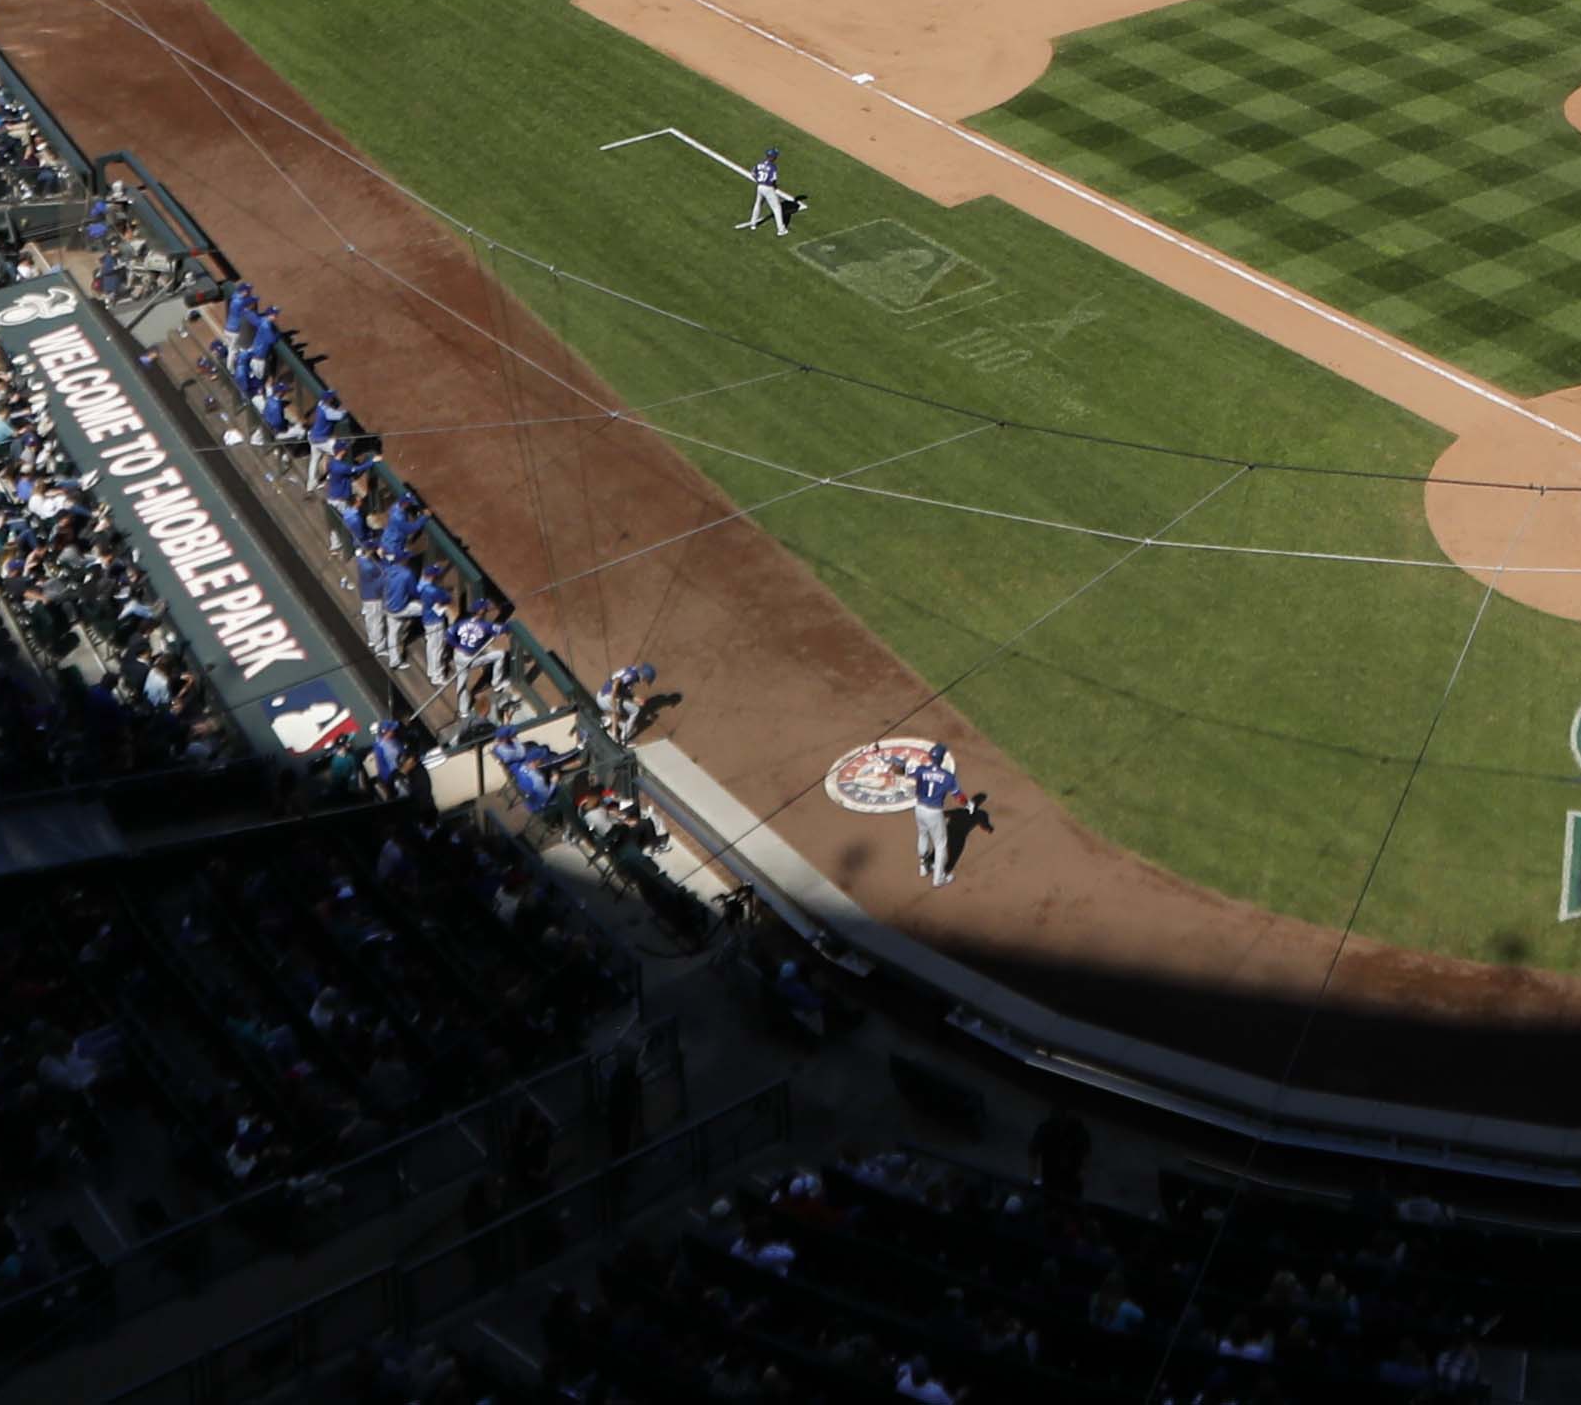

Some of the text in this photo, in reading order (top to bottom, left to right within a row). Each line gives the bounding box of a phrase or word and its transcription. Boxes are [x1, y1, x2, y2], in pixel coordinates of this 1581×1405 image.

[29, 325, 307, 681] WELCOME TO T-MOBILE PARK
